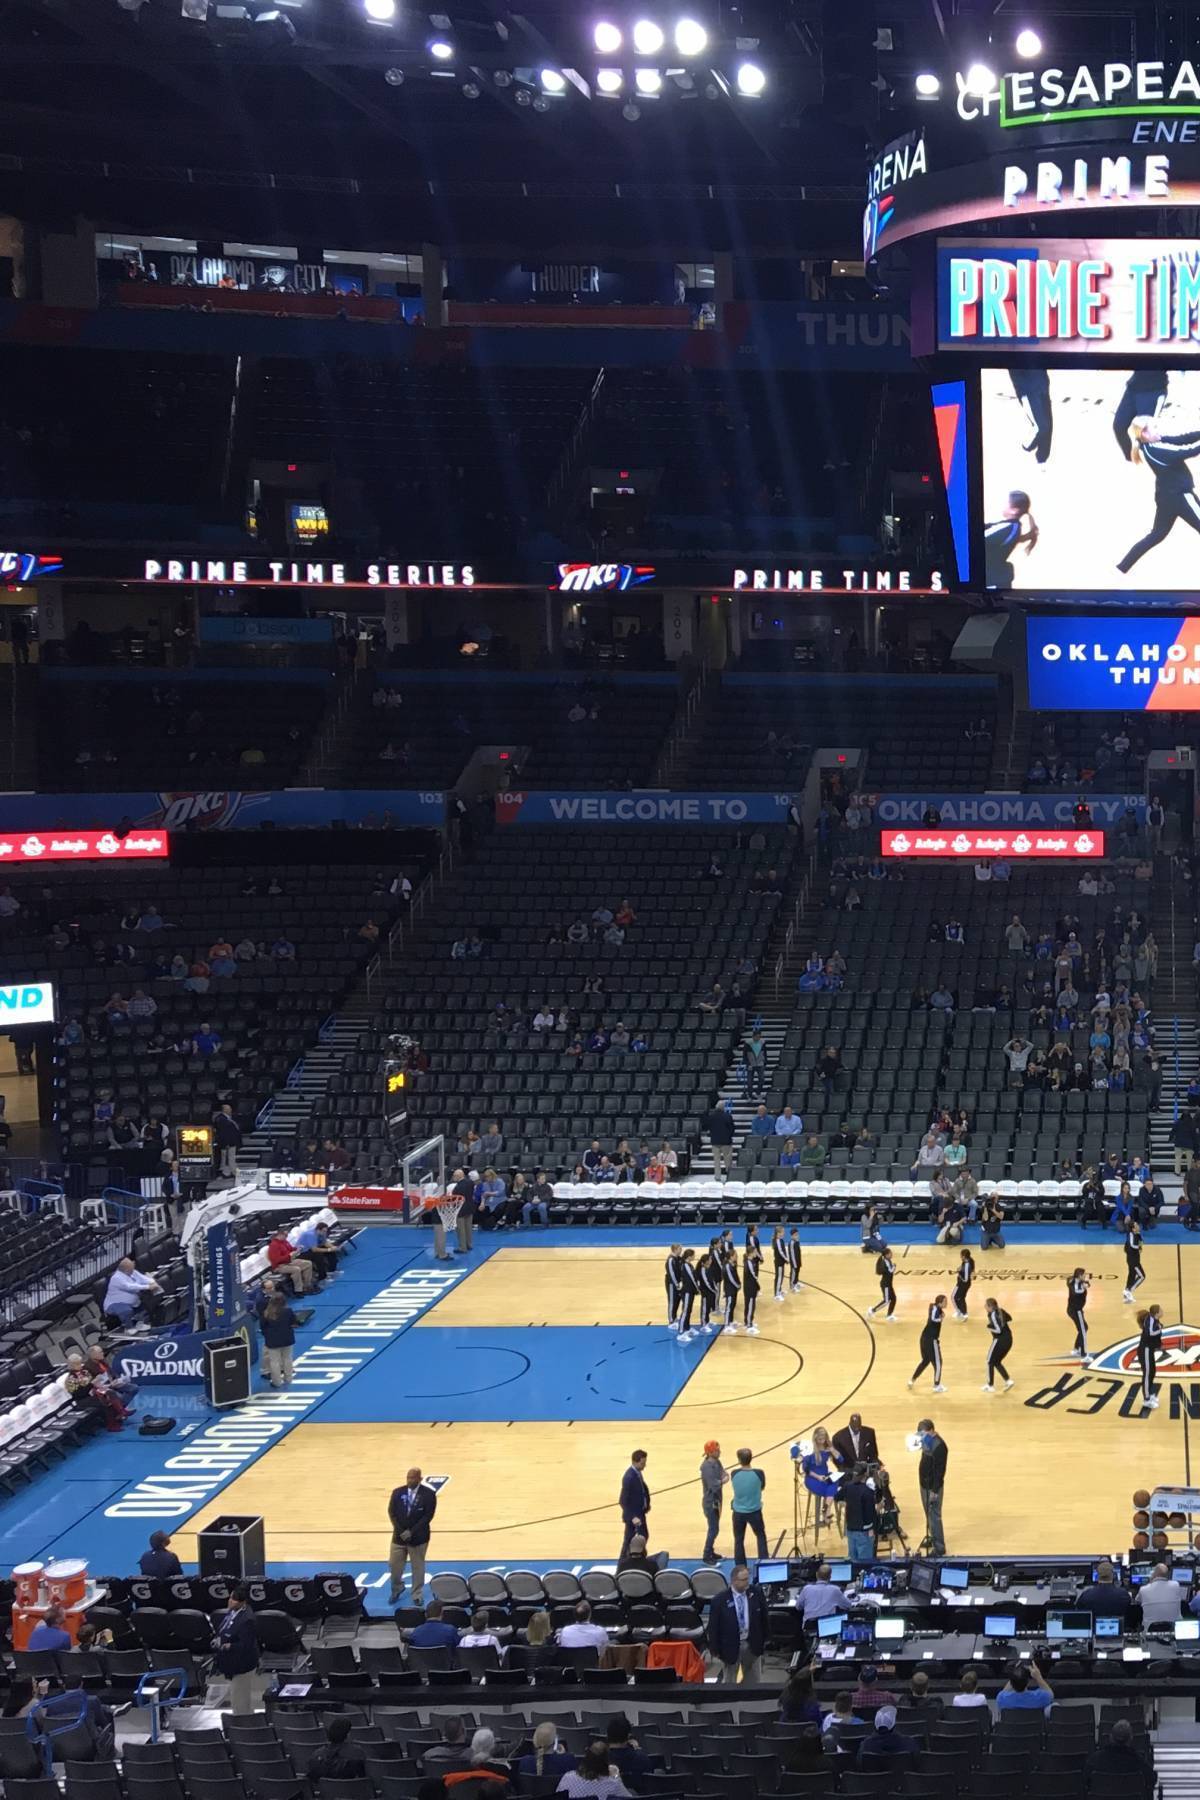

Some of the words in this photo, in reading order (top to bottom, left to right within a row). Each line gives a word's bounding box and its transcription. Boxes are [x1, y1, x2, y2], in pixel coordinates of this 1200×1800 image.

[1003, 155, 1170, 208] PRIME
[170, 256, 255, 285] OKLAHOMA
[294, 264, 327, 290] CITY
[950, 259, 1110, 338] PRIME
[145, 559, 247, 582] PRIME
[269, 562, 345, 584] TIME
[367, 565, 474, 586] SERIES
[559, 565, 619, 591] OKC
[734, 569, 823, 590] PRIME
[843, 570, 910, 591] TIME
[418, 792, 444, 804] 103
[497, 792, 523, 804] 104
[549, 799, 701, 820] WELCOME
[708, 799, 748, 821] TO
[773, 794, 790, 806] 10
[1122, 796, 1147, 807] 105
[878, 800, 1043, 823] OKLAHOMA
[1053, 801, 1121, 823] CTY
[270, 1173, 327, 1188] ENDUI
[216, 1247, 224, 1304] DRAFTKINGS
[322, 1268, 468, 1339] THUNDER
[292, 1345, 375, 1384] CITY
[104, 1391, 324, 1518] OKLAHOMA
